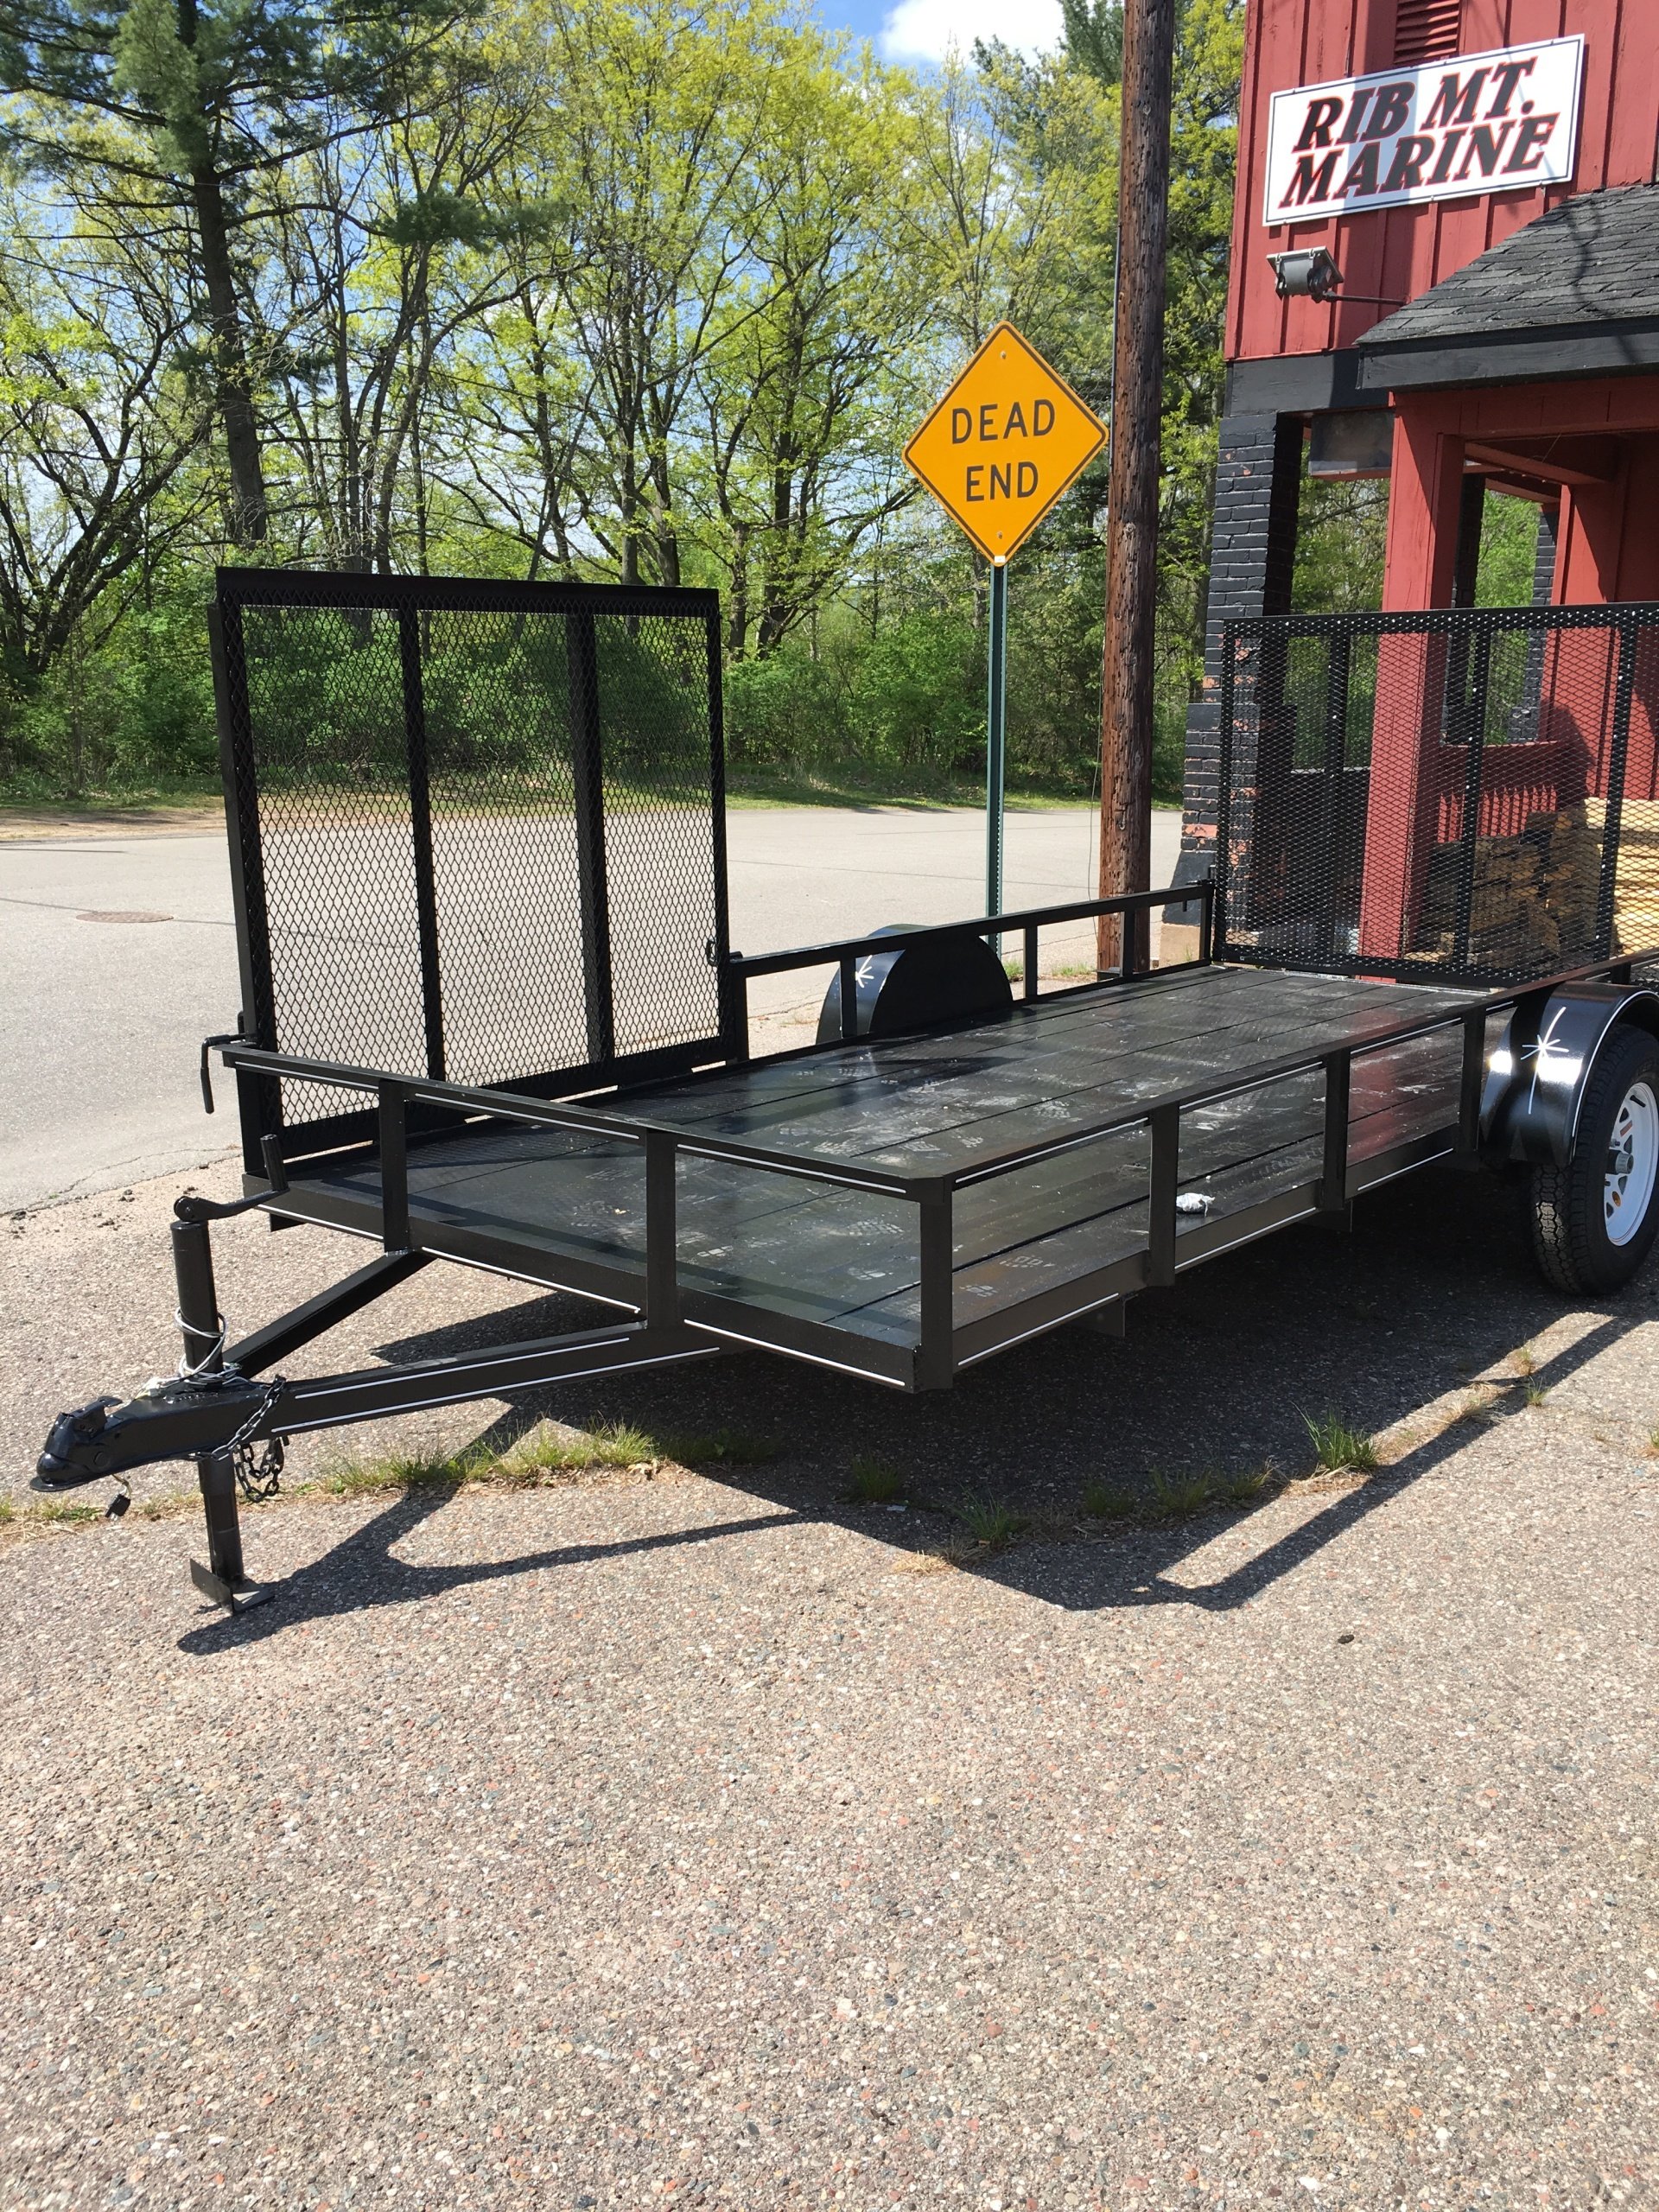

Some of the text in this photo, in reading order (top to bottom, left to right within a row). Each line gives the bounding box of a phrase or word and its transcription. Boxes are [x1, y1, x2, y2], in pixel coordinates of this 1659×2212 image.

[1292, 55, 1538, 154] RIB MT.
[1278, 112, 1560, 209] MARINE
[951, 398, 1056, 445] DEAD
[965, 461, 1039, 502] END
